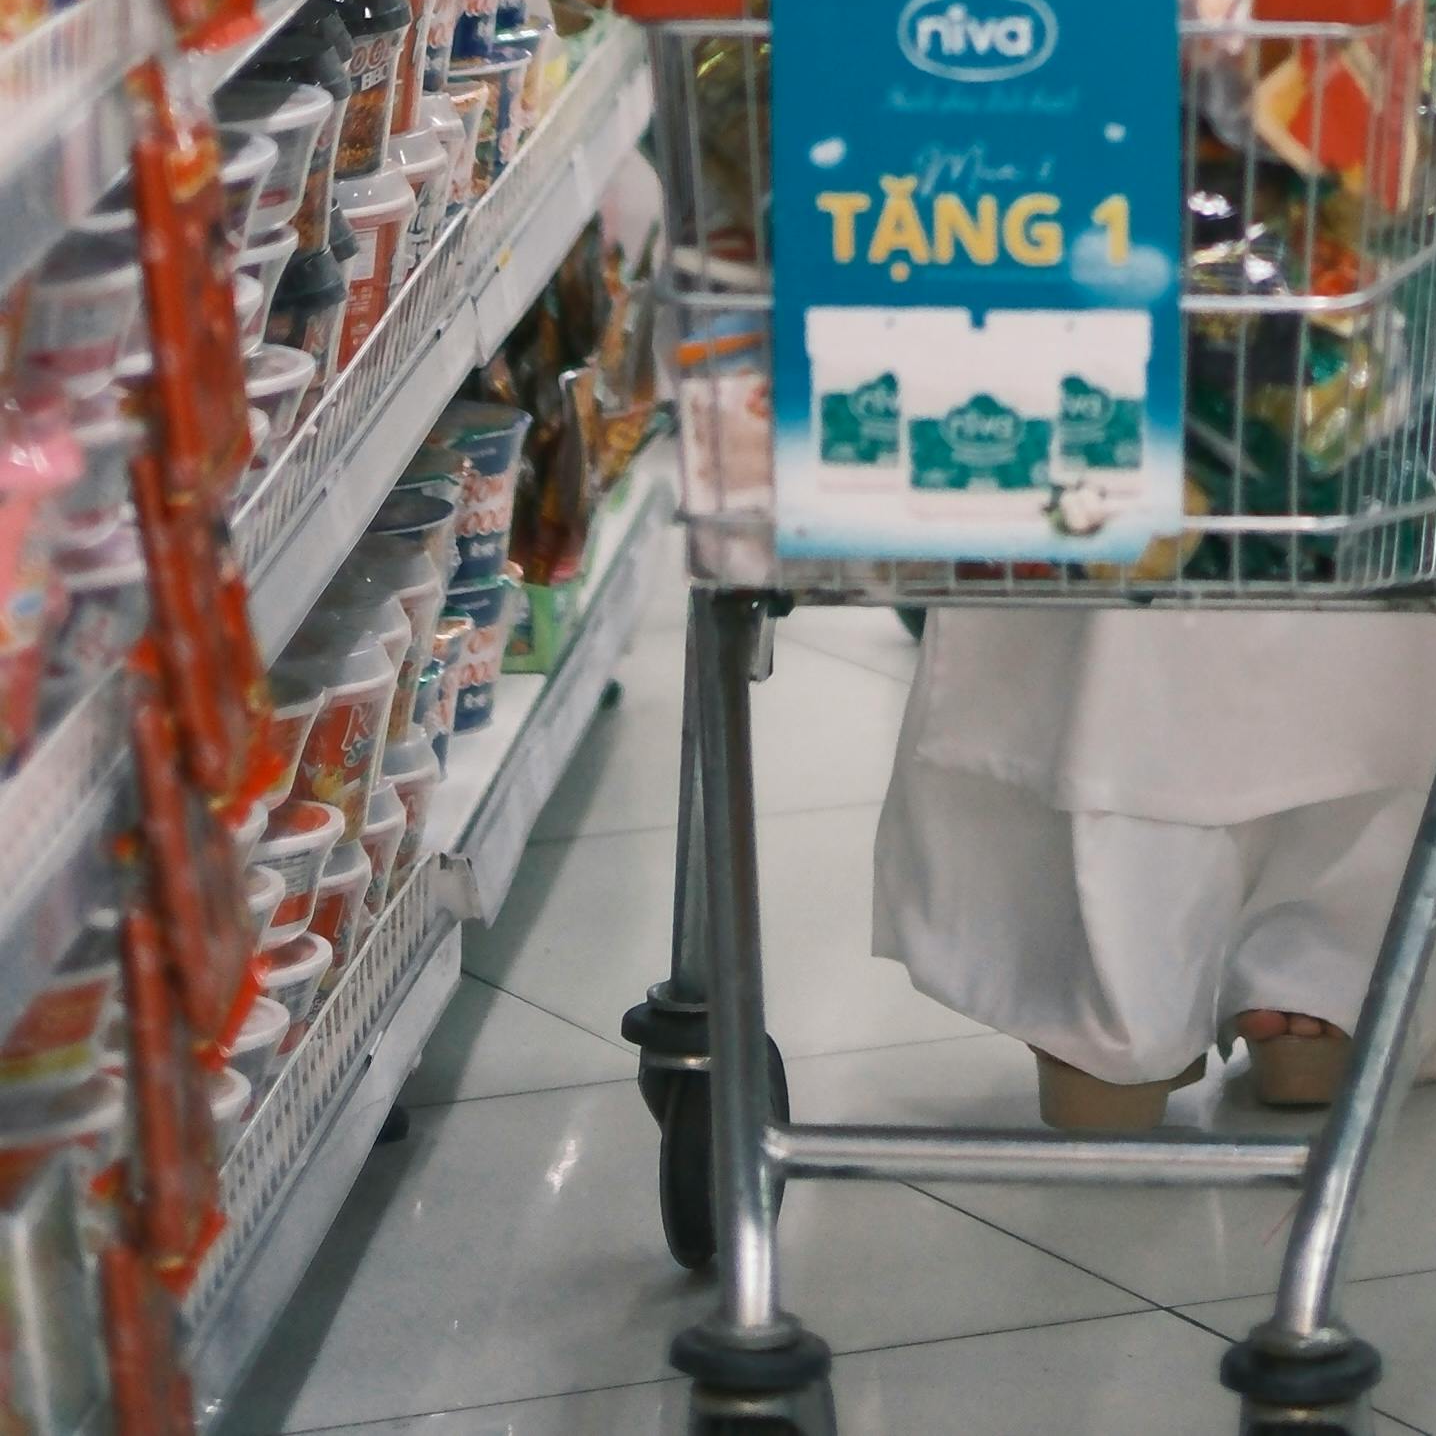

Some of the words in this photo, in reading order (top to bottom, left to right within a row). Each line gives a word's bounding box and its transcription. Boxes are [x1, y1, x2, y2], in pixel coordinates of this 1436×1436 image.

[916, 3, 1033, 57] niva
[815, 172, 1065, 283] TẶNG
[1091, 192, 1129, 265] 1
